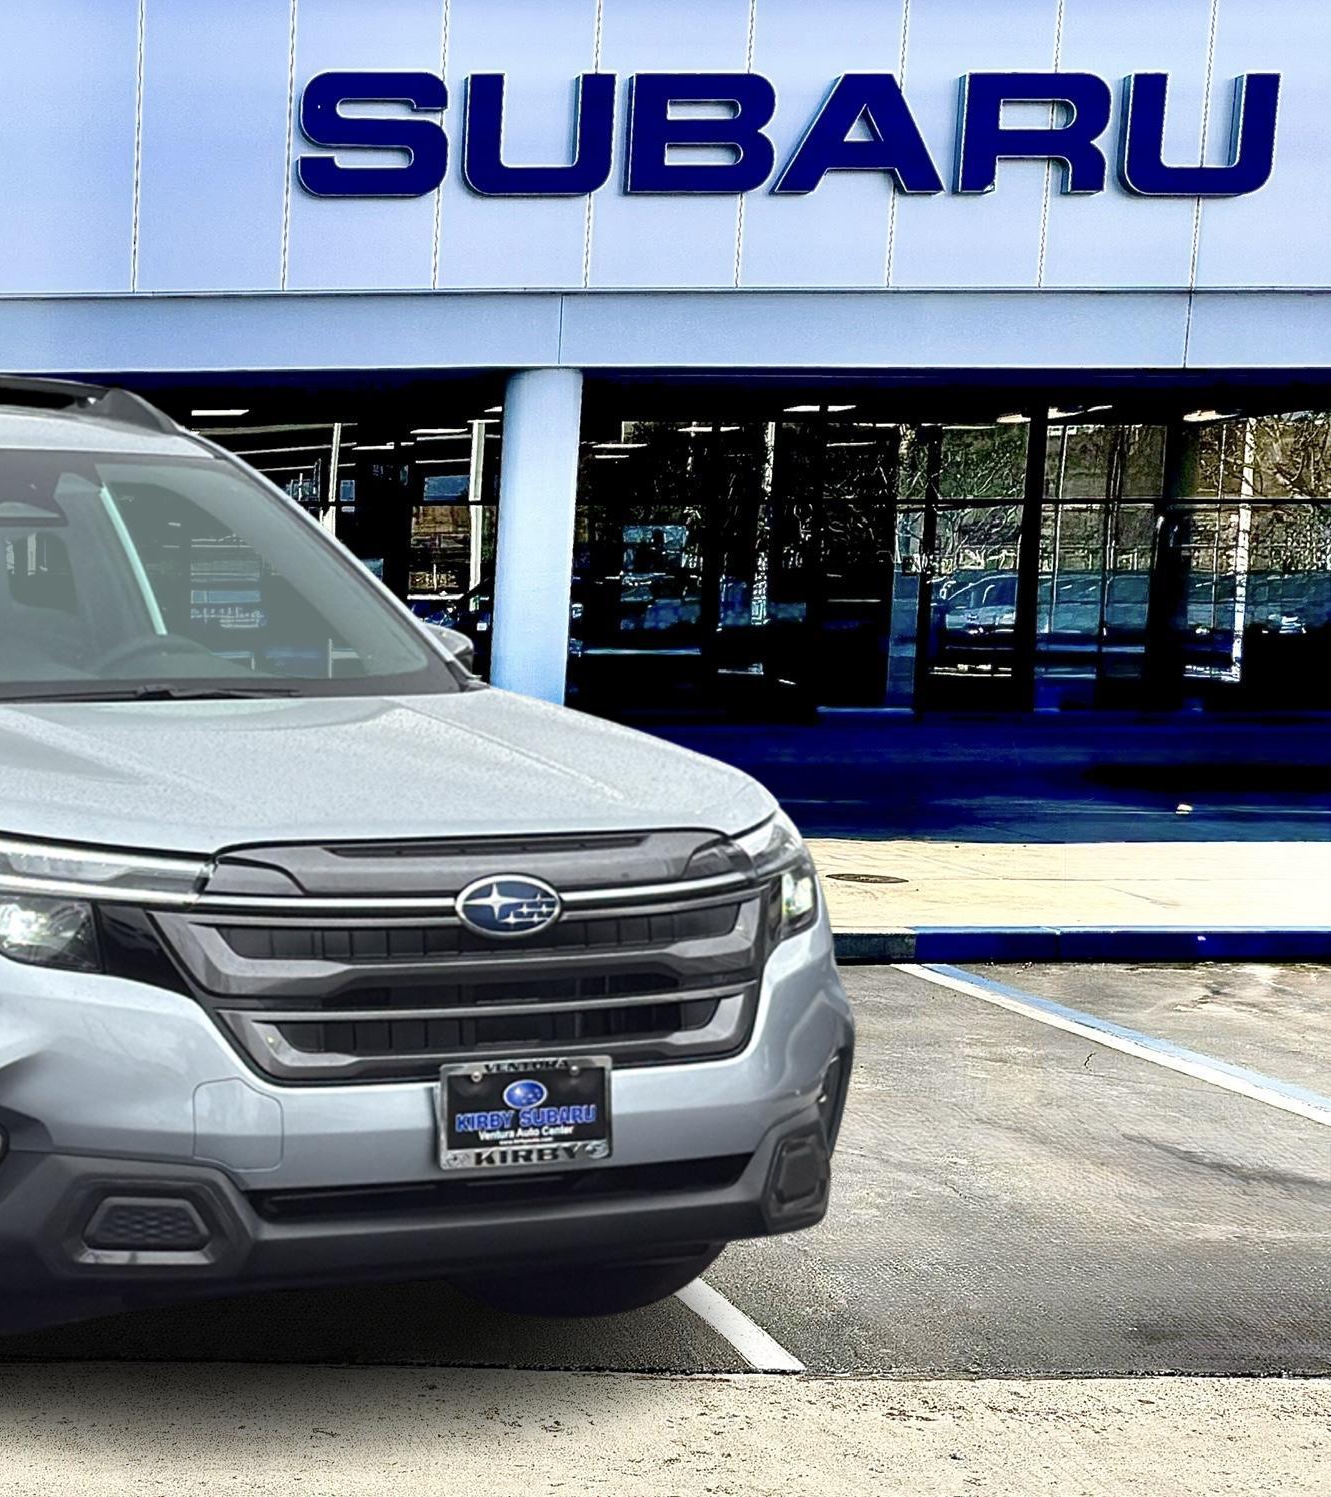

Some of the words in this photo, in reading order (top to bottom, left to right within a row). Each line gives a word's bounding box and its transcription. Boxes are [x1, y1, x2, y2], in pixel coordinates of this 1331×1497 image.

[297, 72, 1281, 196] SUBARU
[455, 1110, 514, 1132] KIRBY
[519, 1104, 596, 1127] SUBARU
[478, 1129, 515, 1140] Ventura
[516, 1127, 539, 1138] Auto
[541, 1125, 574, 1136] Center
[474, 1143, 582, 1166] KIRBY
